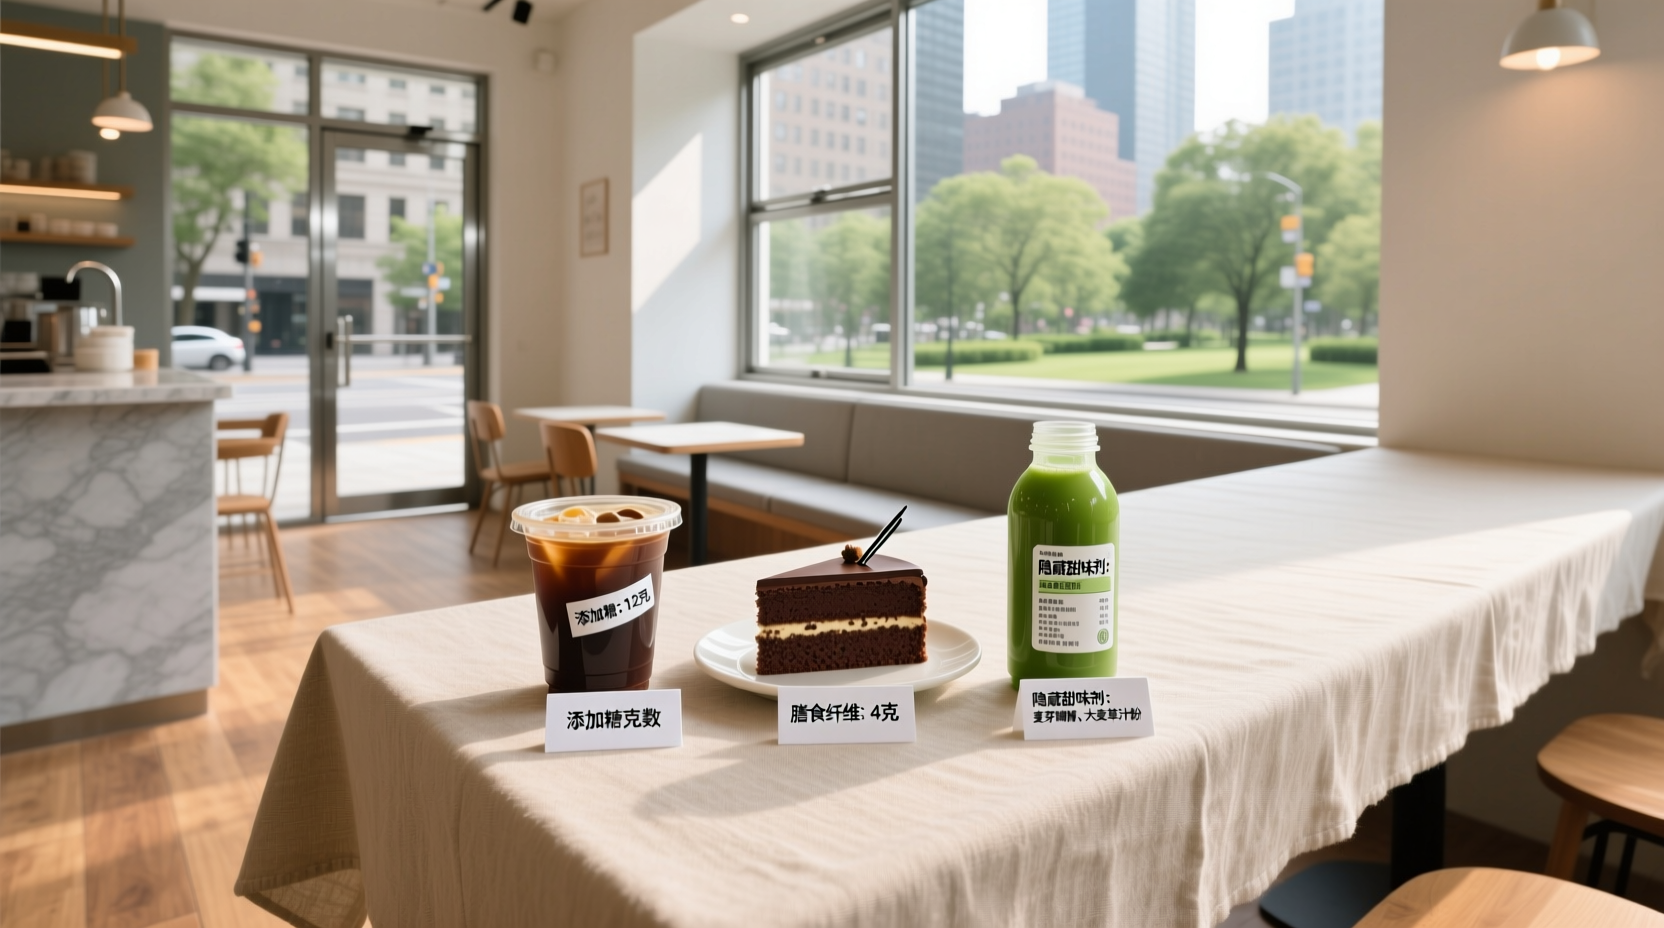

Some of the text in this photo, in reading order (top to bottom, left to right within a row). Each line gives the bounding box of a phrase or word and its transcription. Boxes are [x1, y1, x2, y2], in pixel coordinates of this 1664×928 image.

[566, 707, 662, 730] 添加糖克数
